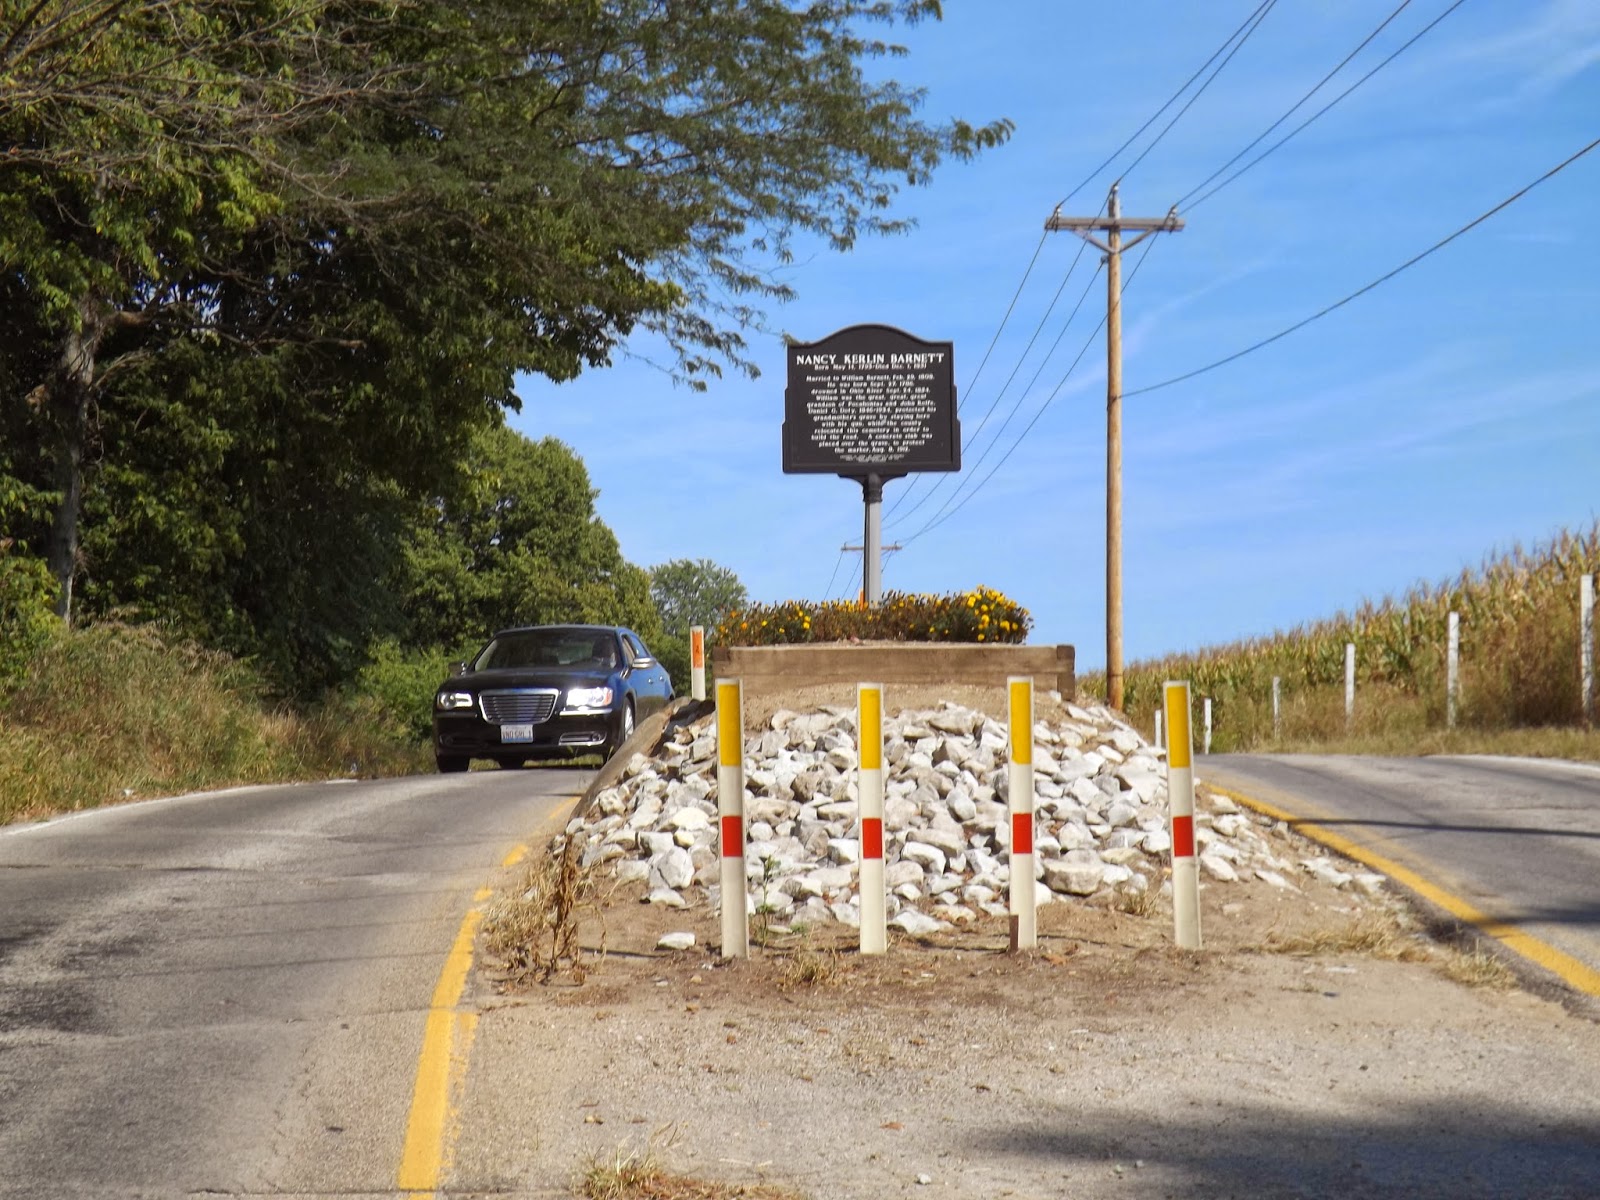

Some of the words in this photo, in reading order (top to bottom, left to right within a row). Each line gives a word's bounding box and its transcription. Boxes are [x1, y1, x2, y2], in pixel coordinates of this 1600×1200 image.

[796, 354, 836, 365] NANCY
[844, 354, 884, 364] KERLIN
[890, 352, 944, 364] BARNETT
